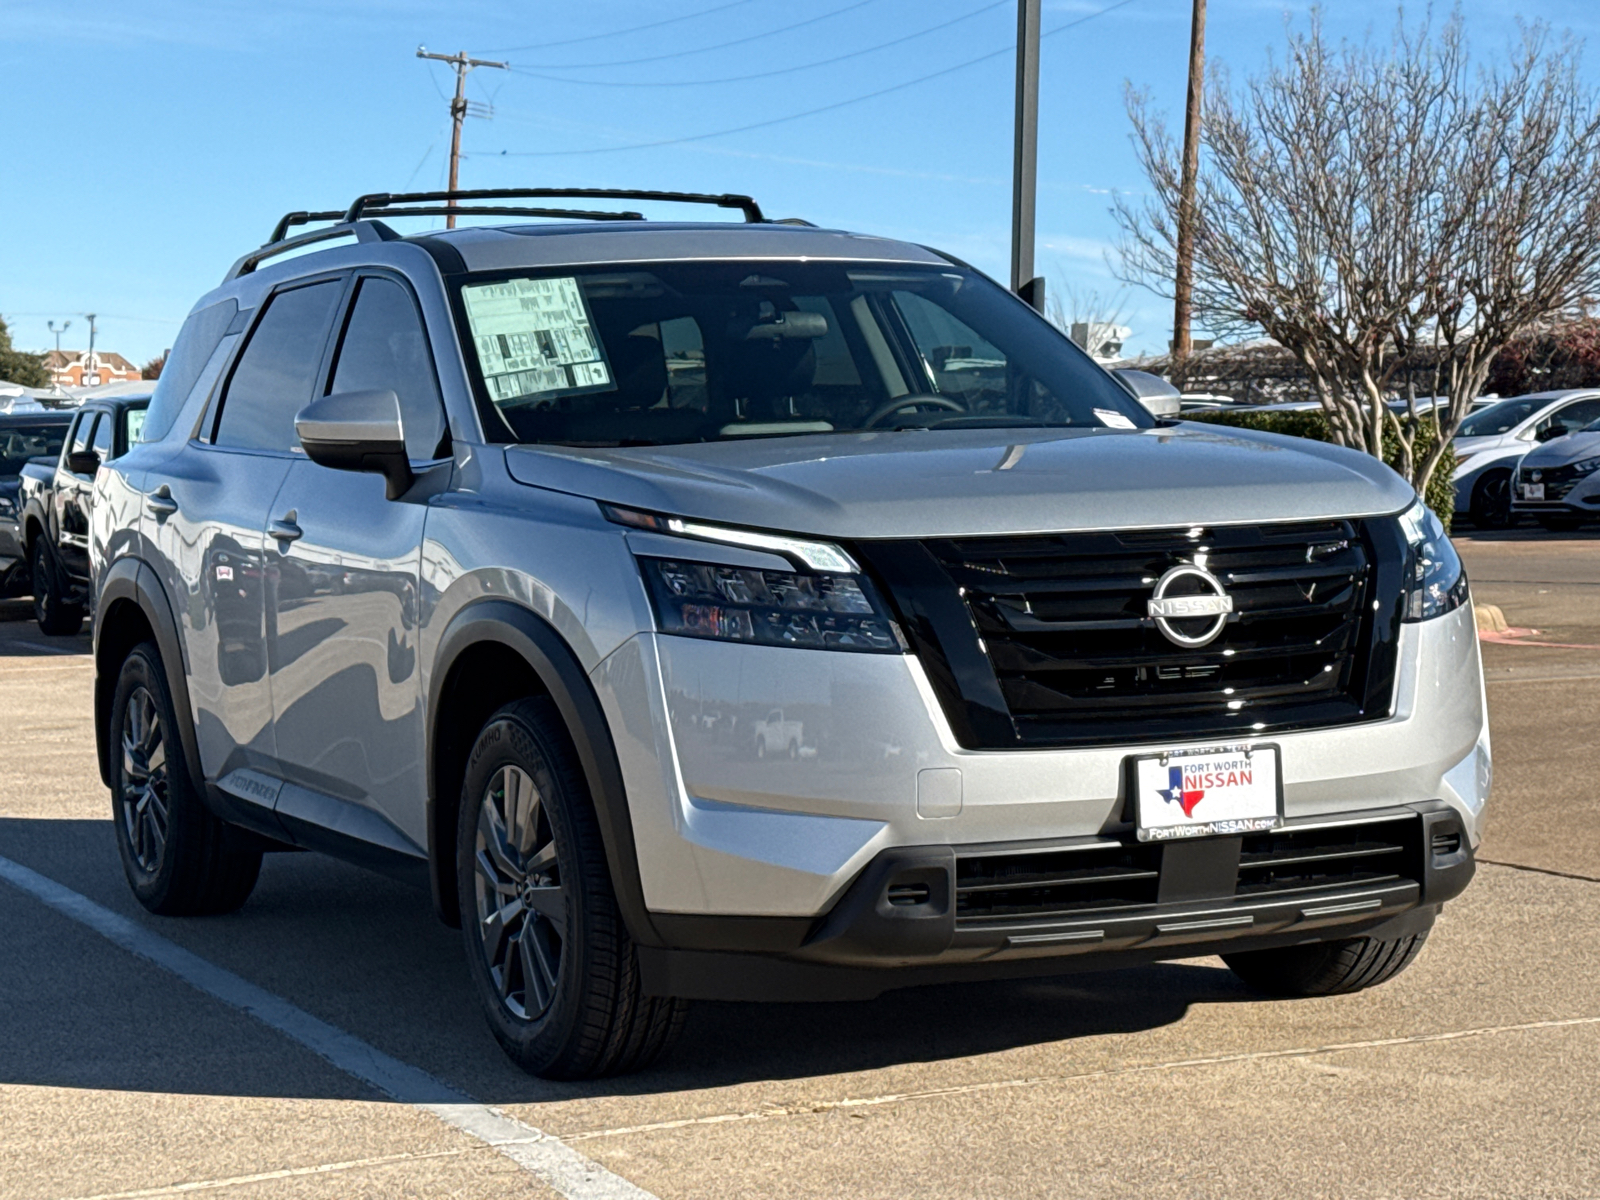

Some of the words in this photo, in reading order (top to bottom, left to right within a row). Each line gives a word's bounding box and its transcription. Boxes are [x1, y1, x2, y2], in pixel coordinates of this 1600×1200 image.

[1149, 598, 1232, 615] NISSAN
[1184, 763, 1211, 774] FORT
[1213, 760, 1252, 772] WORTH
[1185, 770, 1253, 790] NISSAN
